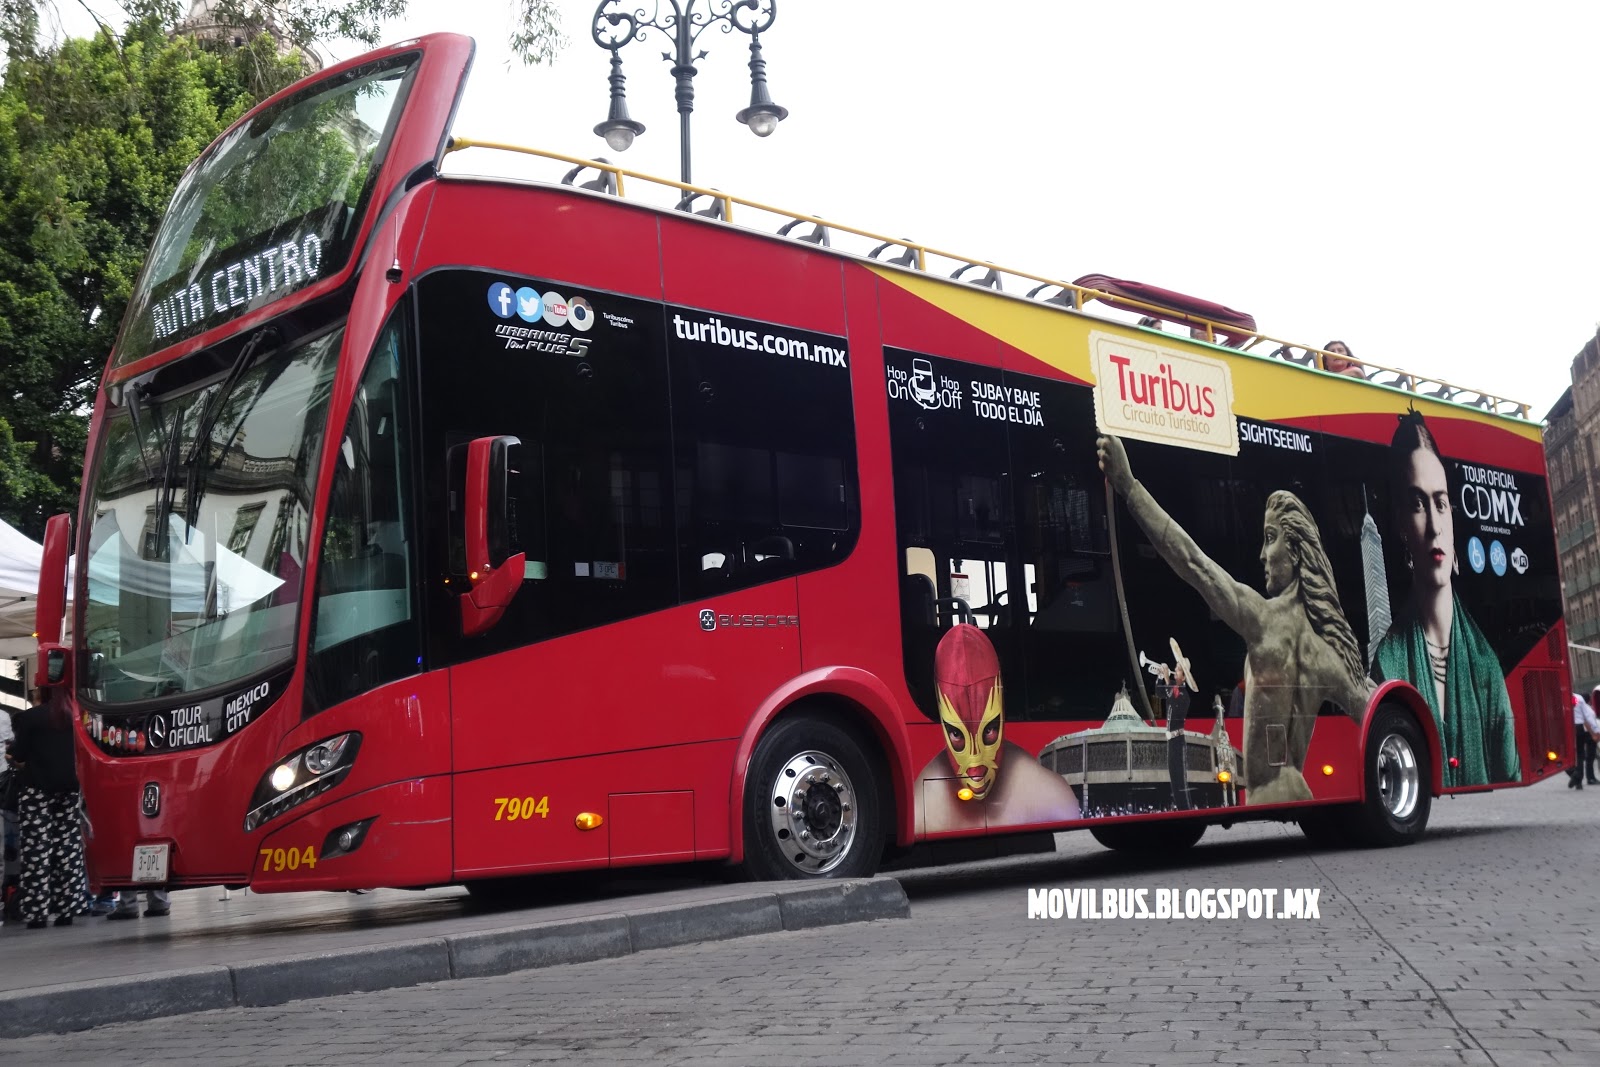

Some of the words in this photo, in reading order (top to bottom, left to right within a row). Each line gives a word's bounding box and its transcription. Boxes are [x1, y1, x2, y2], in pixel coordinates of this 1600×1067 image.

[211, 233, 322, 313] CENTRO
[544, 303, 567, 316] YouTube
[609, 319, 628, 329] Turibus
[673, 314, 847, 368] turibus.com.mx
[886, 364, 907, 383] Hop
[940, 375, 960, 392] Hop
[1109, 354, 1216, 418] Turibus
[888, 379, 909, 401] On
[941, 389, 963, 409] Off
[971, 380, 1005, 402] SUBA
[1003, 386, 1013, 403] Y
[1014, 388, 1041, 409] BAJE
[972, 399, 1007, 422] TODO
[1008, 411, 1023, 424] EL
[1024, 406, 1045, 427] DÍA
[1122, 403, 1166, 427] Circuito
[1167, 412, 1210, 435] Turístico
[1240, 421, 1312, 454] SIGHTSEEING
[1462, 464, 1488, 485] TOUR
[1487, 469, 1518, 491] OFICIAL
[1461, 483, 1525, 527] CDMX
[718, 614, 799, 628] BUSSCAR
[225, 681, 270, 719] MEXICO
[170, 705, 202, 728] TOUR
[227, 706, 252, 733] CITY
[169, 724, 213, 748] OFICIAL
[494, 796, 550, 821] 7904
[260, 845, 317, 872] 7904
